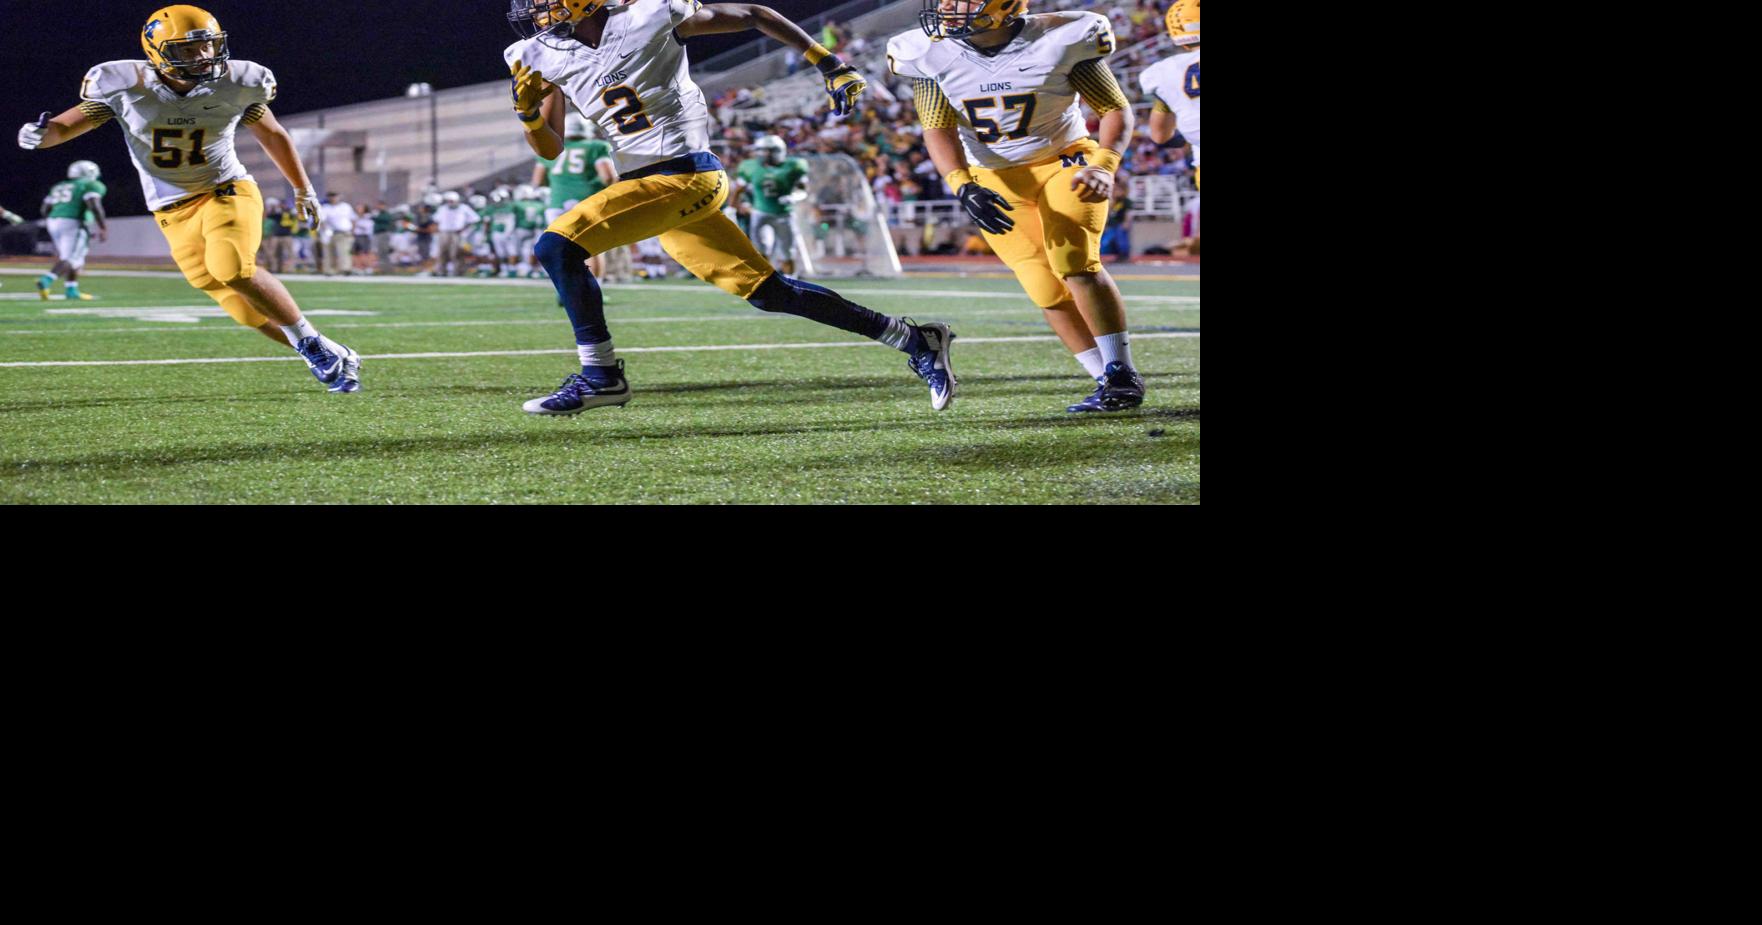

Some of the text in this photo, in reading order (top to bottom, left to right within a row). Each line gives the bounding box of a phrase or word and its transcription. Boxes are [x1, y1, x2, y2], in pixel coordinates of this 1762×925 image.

[596, 70, 628, 87] LIONS
[980, 81, 1012, 93] LIONS
[602, 84, 654, 135] 2
[961, 91, 1038, 144] 57
[167, 117, 196, 126] LIONS
[152, 127, 207, 168] 51
[1058, 150, 1089, 168] M
